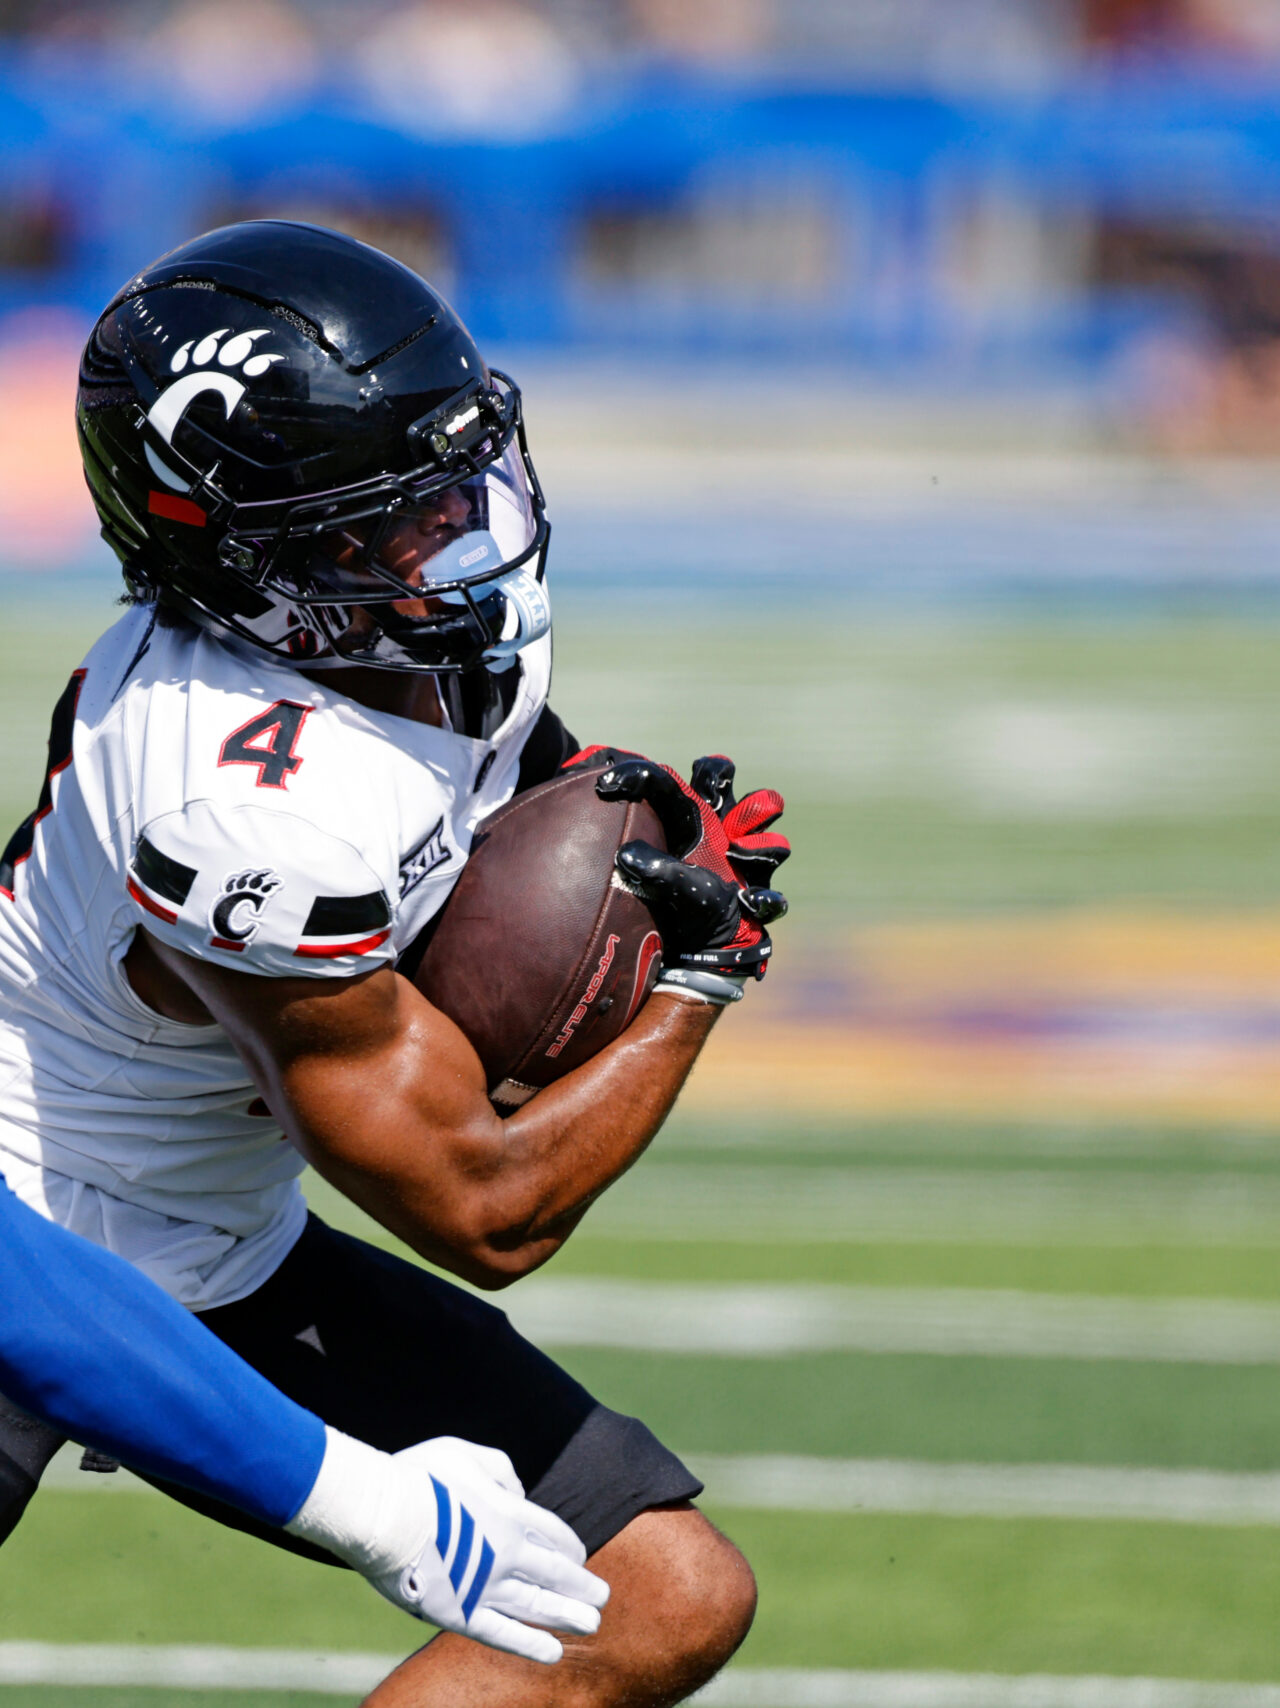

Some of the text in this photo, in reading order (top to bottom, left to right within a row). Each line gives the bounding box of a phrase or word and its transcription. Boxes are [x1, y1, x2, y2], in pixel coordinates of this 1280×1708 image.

[217, 699, 317, 791] 4
[545, 933, 621, 1058] VAPOR ELITE
